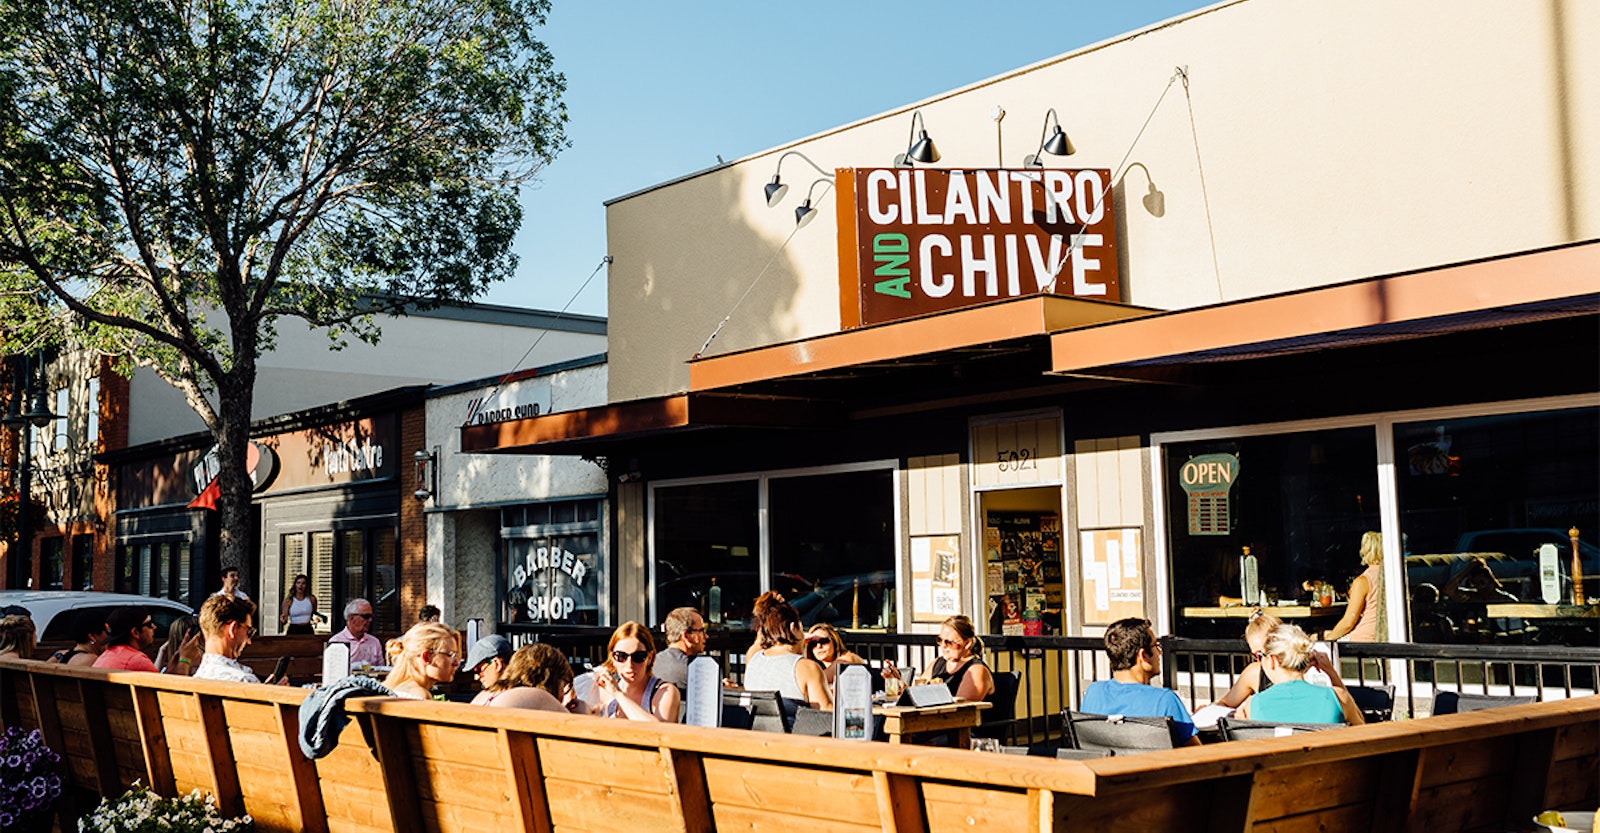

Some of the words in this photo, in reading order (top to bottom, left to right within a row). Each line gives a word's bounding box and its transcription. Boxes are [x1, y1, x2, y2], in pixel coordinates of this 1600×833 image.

[866, 169, 1105, 225] CILANTRO
[873, 233, 912, 299] AND
[919, 234, 1107, 297] CHIVE
[514, 403, 540, 419] SHOP
[997, 447, 1038, 473] 5021
[1183, 462, 1231, 485] OPEN
[513, 546, 587, 588] BARBER
[527, 596, 575, 620] SHOP
